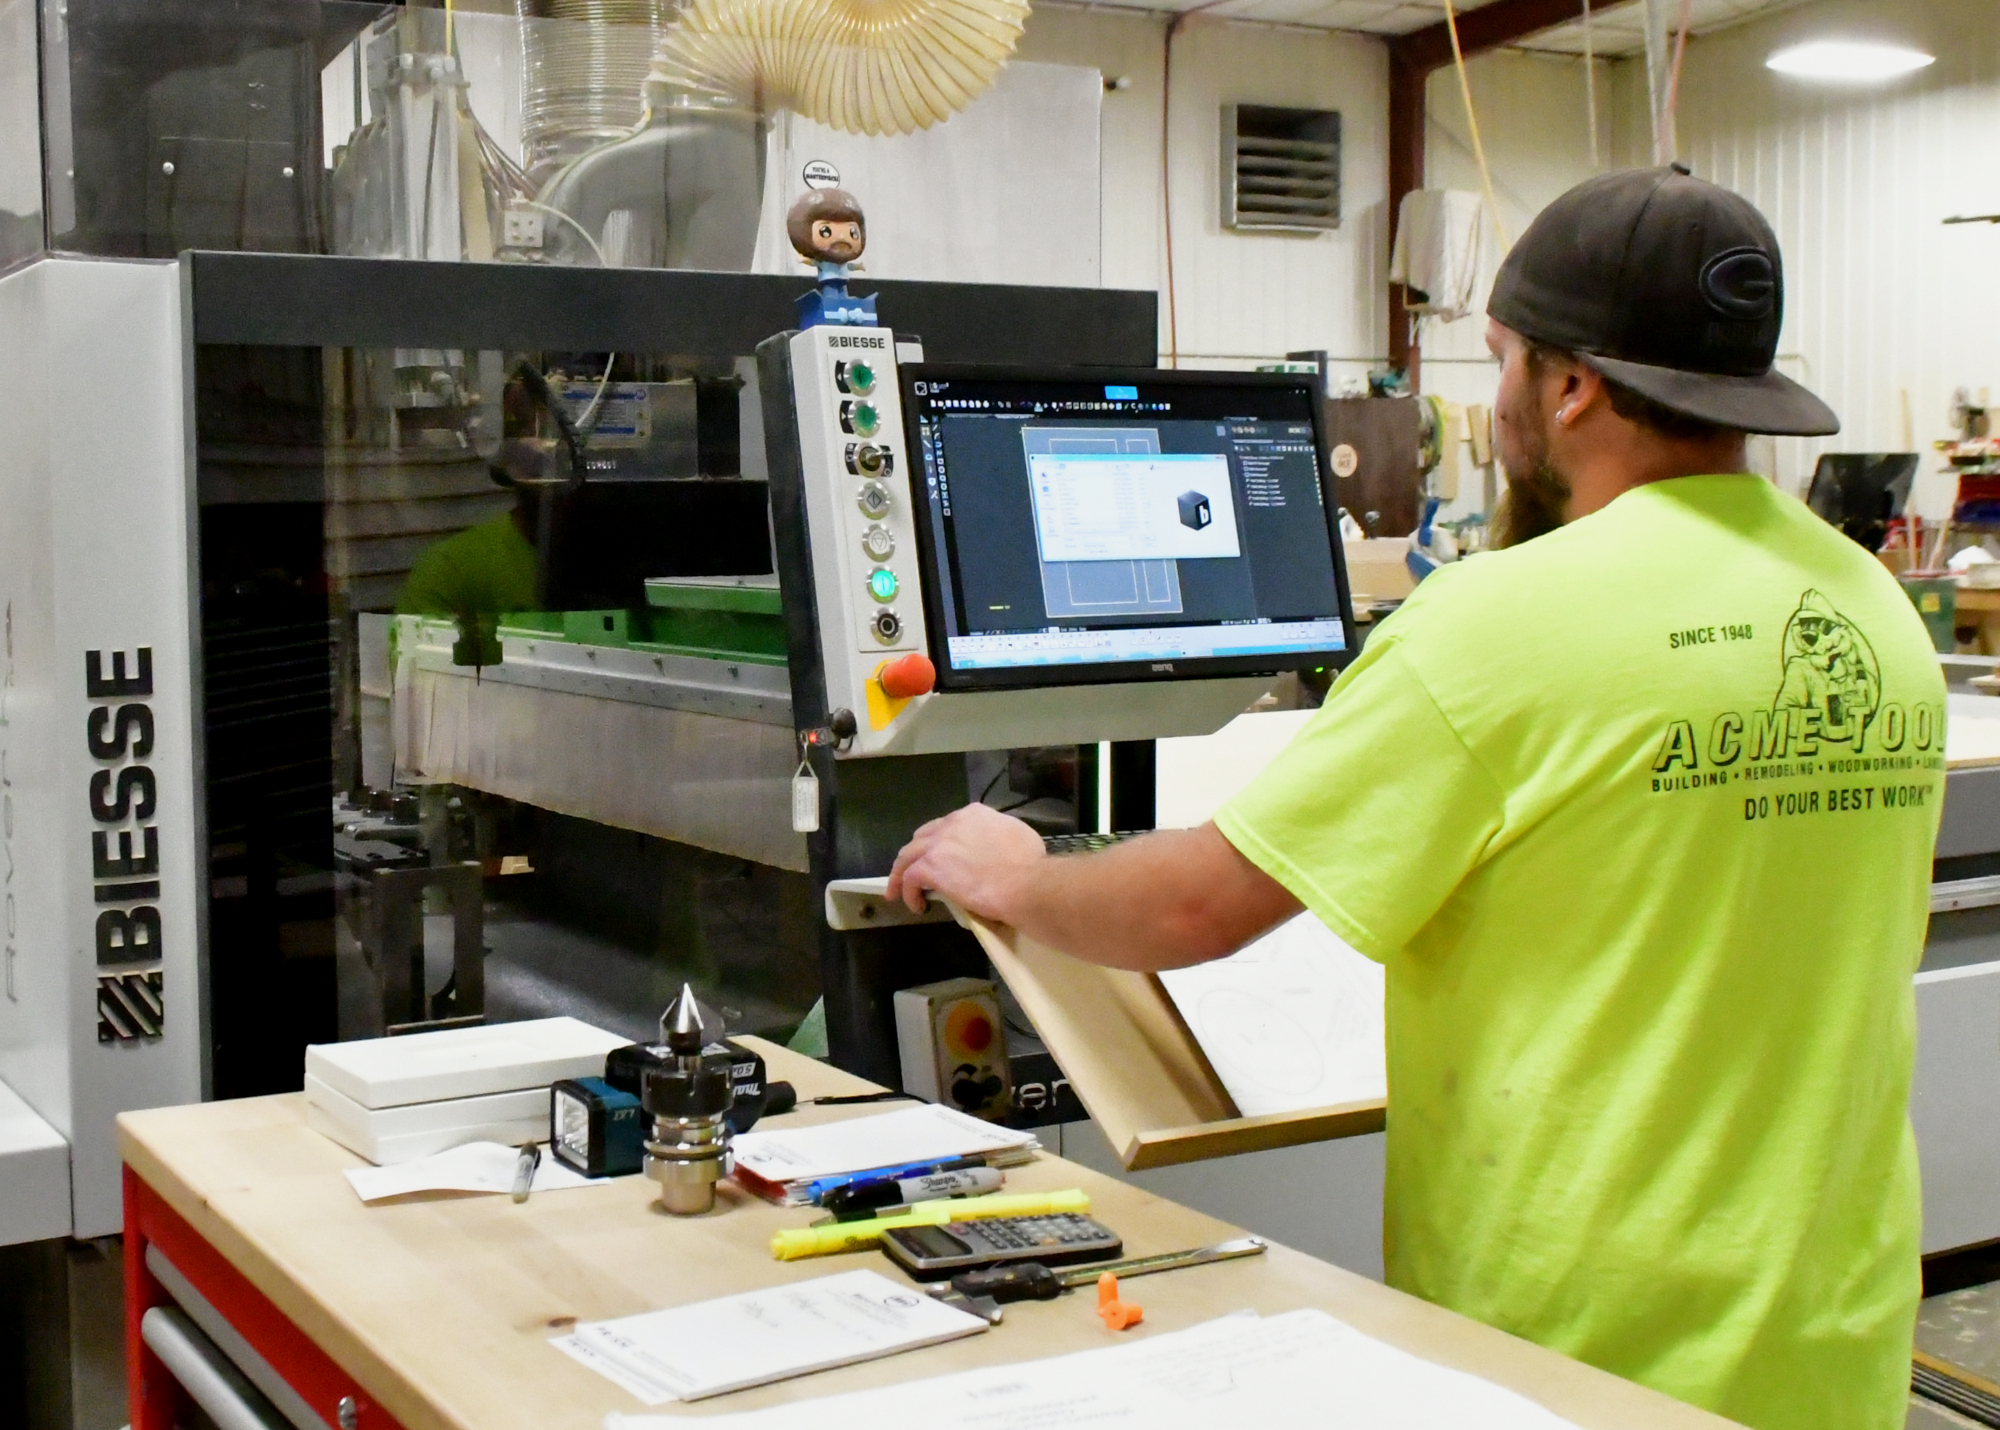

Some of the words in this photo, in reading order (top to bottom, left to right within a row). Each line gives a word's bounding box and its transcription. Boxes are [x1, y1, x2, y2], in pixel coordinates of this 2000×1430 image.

[840, 336, 885, 349] BIESSE
[1669, 626, 1717, 649] SINCE
[1720, 624, 1753, 641] 1948
[1651, 706, 1822, 773] ACME
[1651, 770, 1728, 792] BUILDING
[1744, 762, 1814, 780] REMODELING
[1828, 756, 1912, 773] WOODWORKING
[86, 646, 163, 965] BIESSE
[1744, 796, 1769, 820] DO
[1775, 791, 1819, 816] YOUR
[1827, 787, 1874, 811] BEST
